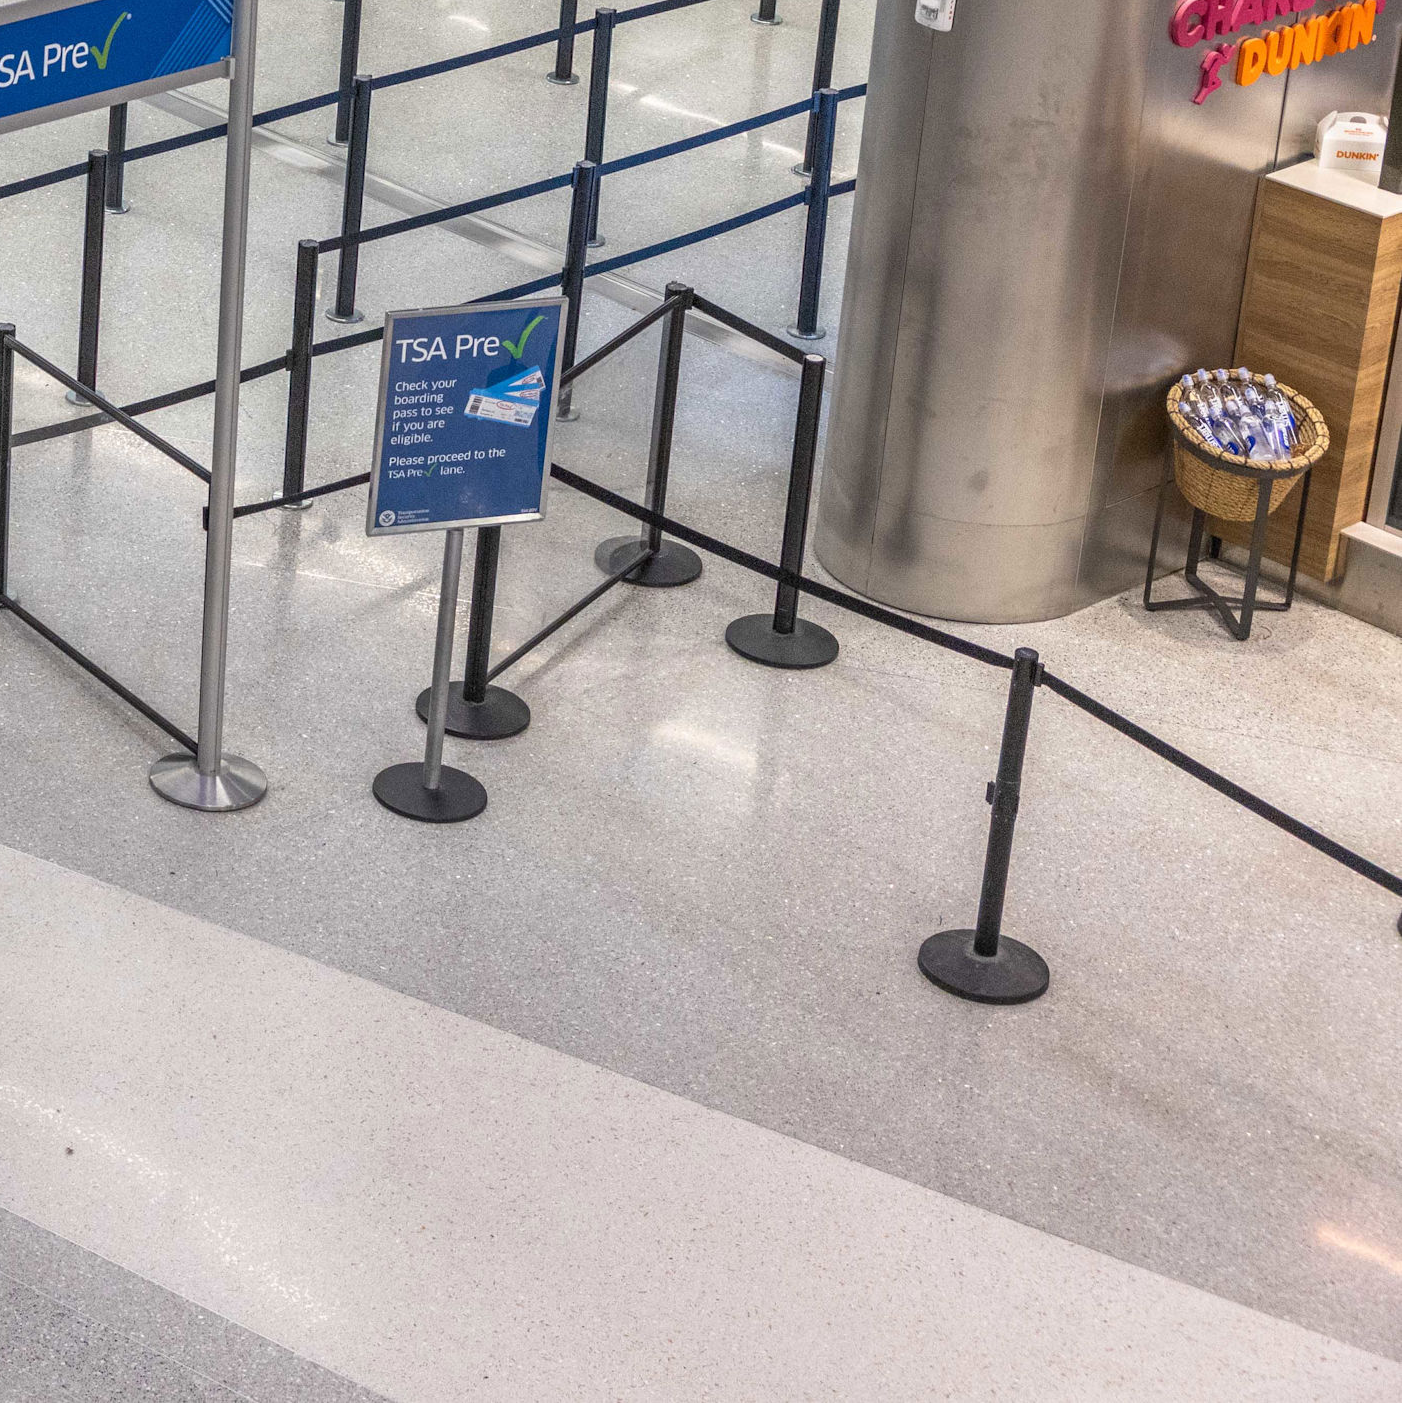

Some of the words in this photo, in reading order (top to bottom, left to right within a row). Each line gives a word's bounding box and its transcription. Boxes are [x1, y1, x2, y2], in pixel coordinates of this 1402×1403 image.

[42, 41, 89, 77] Pre
[1336, 150, 1380, 161] DUNKIN'
[395, 336, 447, 364] TSA
[455, 334, 500, 359] Pre
[395, 380, 429, 392] Check
[431, 378, 458, 391] your
[394, 392, 444, 405] boarding
[393, 407, 418, 420] pass
[420, 406, 432, 417] to
[434, 405, 454, 415] see
[391, 421, 400, 432] if
[403, 421, 425, 433] you
[427, 419, 446, 429] are
[390, 433, 434, 446] eligible.
[389, 454, 425, 467] Please
[427, 450, 472, 465] proceed
[474, 449, 486, 460] to
[488, 448, 506, 458] the
[388, 470, 406, 479] TSA
[407, 468, 424, 478] Pre
[440, 465, 466, 476] lane.
